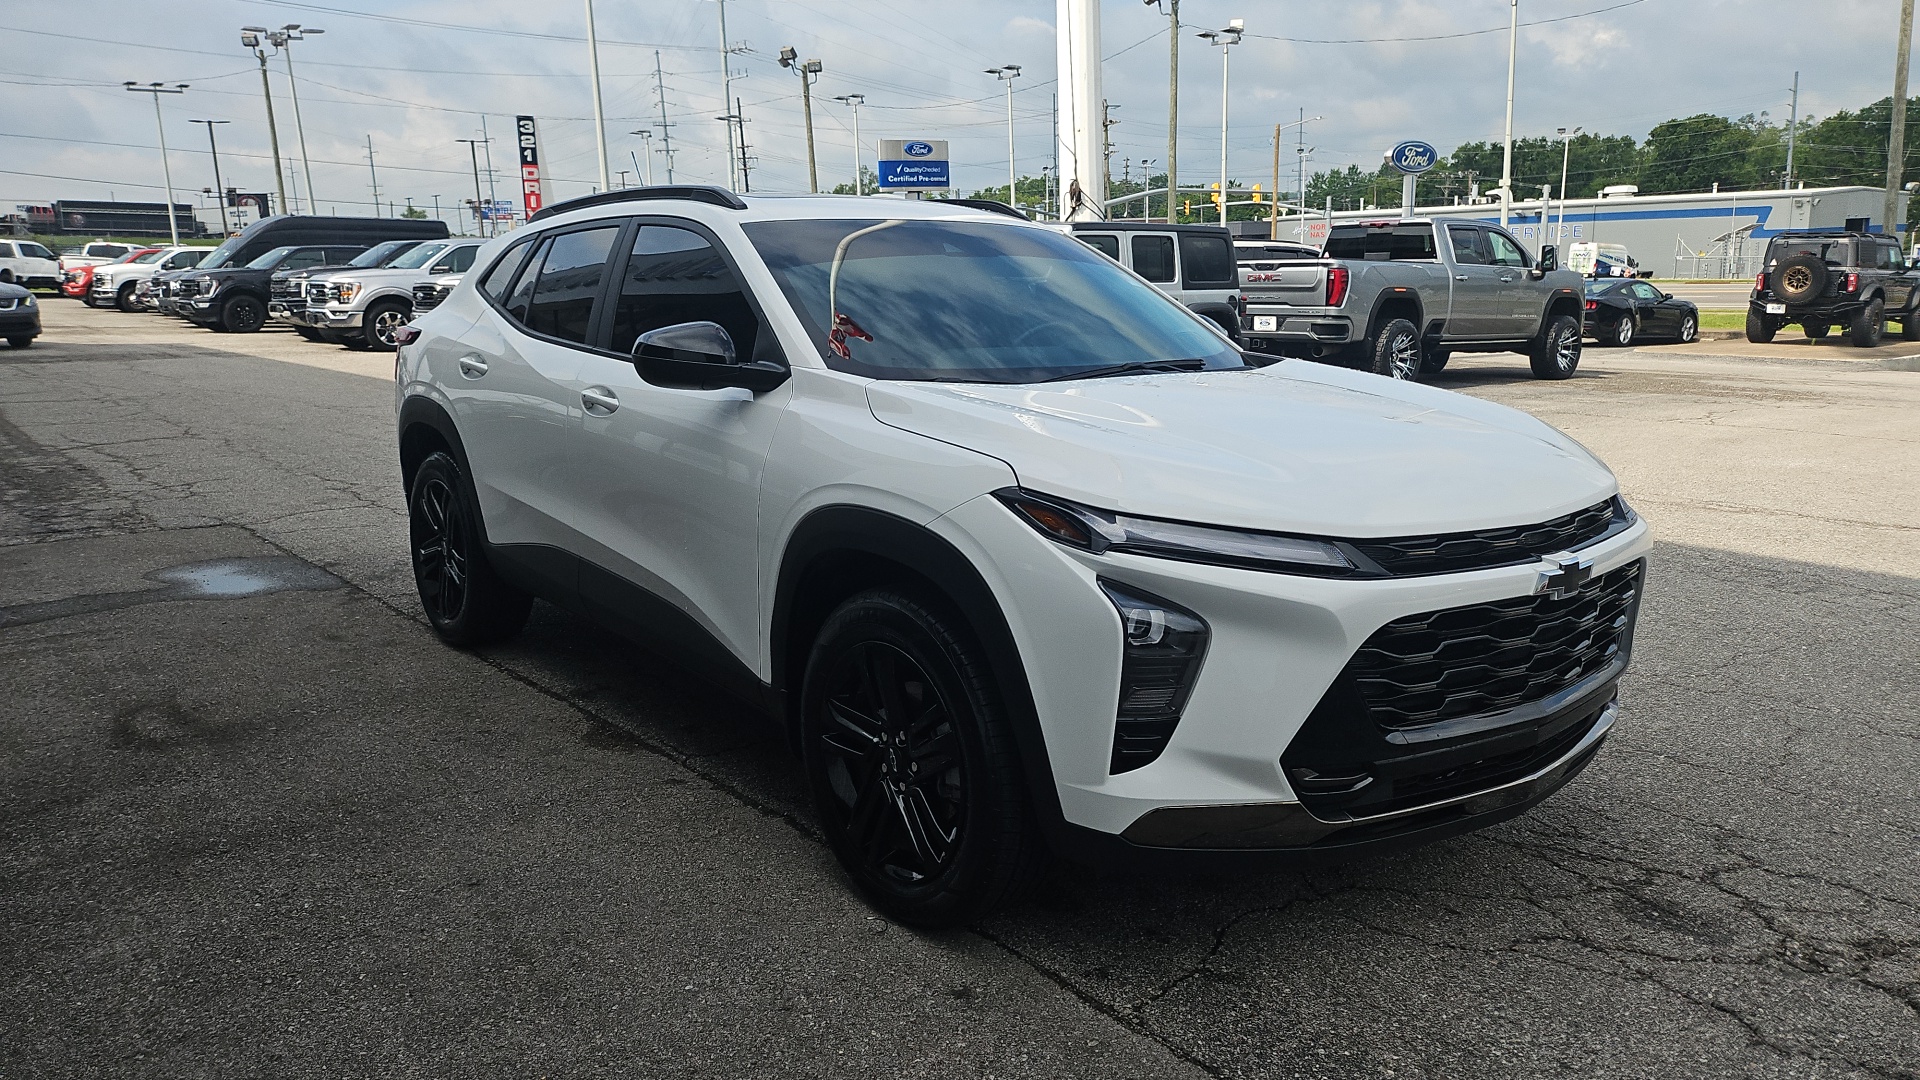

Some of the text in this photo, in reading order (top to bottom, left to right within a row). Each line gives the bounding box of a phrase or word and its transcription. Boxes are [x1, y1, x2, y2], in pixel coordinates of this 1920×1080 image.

[519, 120, 536, 162] 321
[911, 144, 929, 154] Ford
[1401, 145, 1430, 167] Ford
[1247, 272, 1283, 282] GMC
